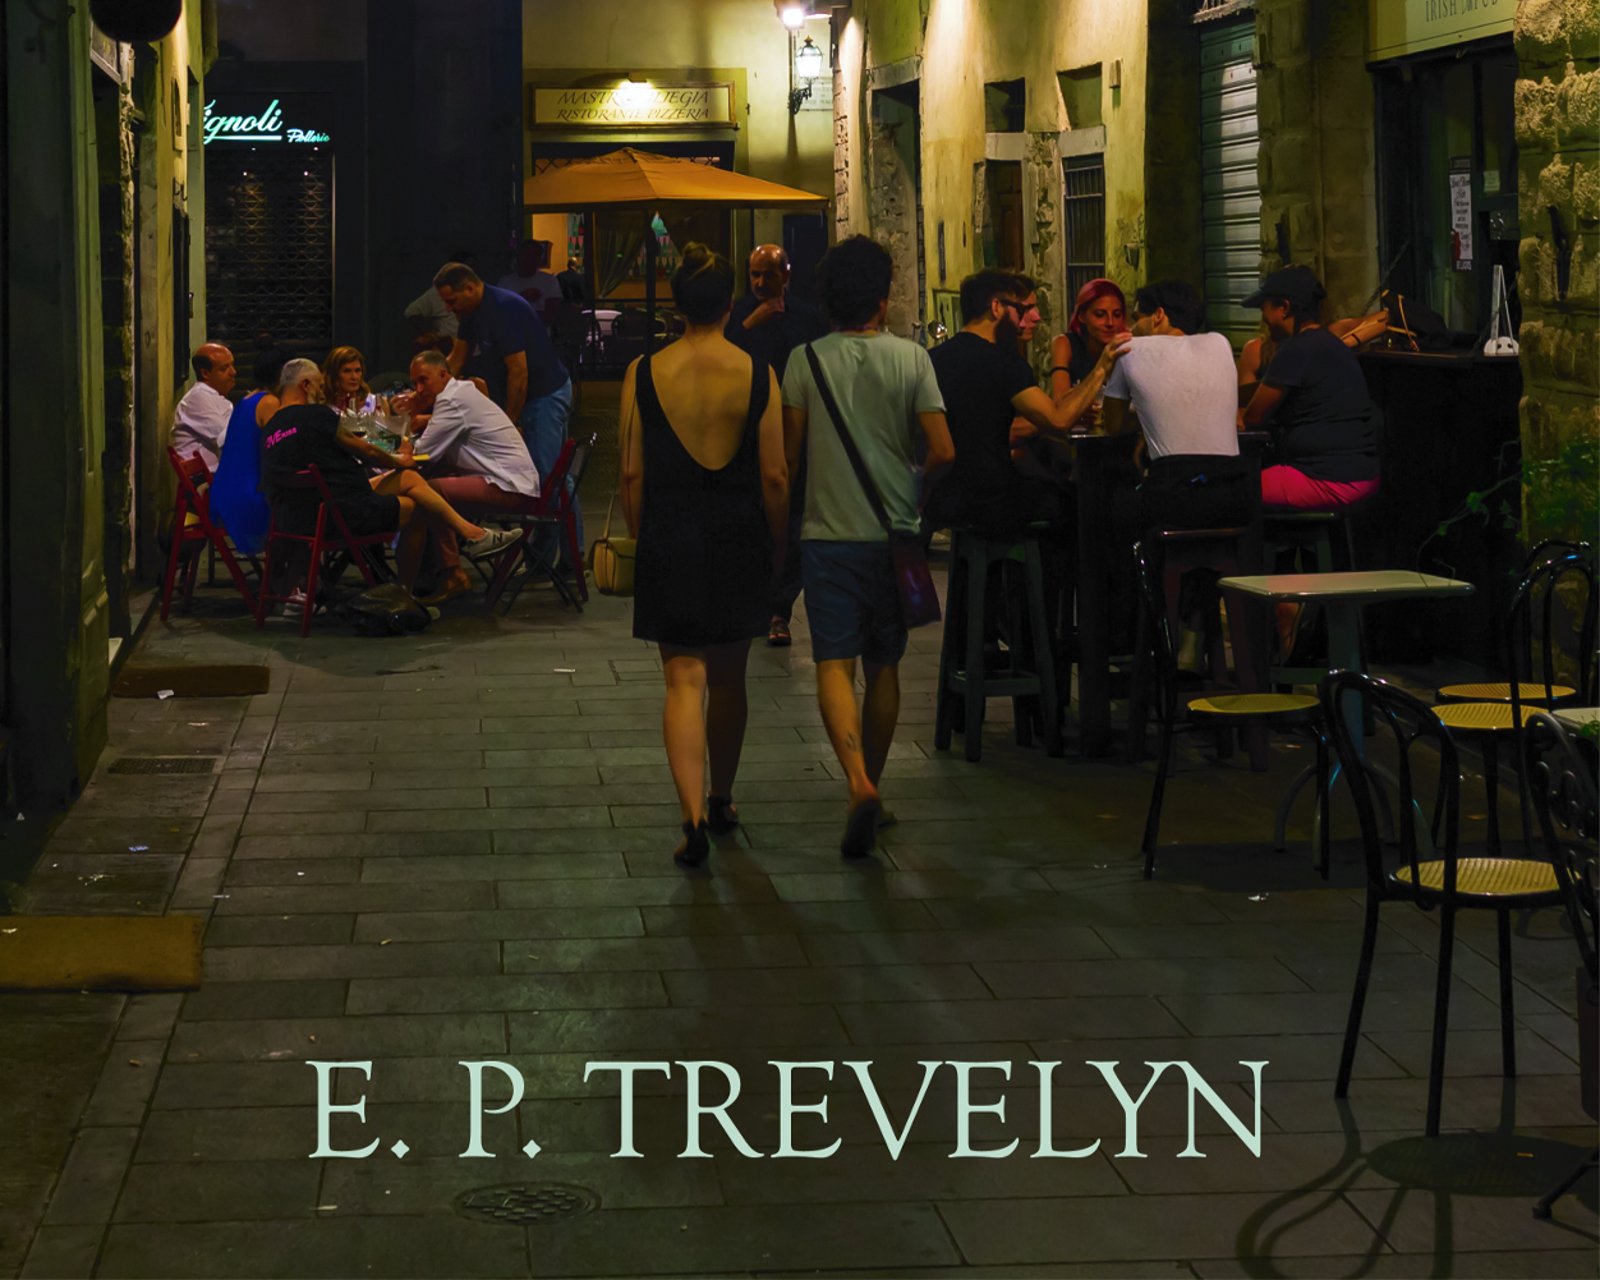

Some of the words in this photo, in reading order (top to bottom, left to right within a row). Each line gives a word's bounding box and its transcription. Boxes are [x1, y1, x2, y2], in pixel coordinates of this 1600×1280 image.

[557, 91, 629, 106] MASTR
[556, 107, 642, 121] RISTORANTE
[646, 107, 709, 120] PIZZERIA
[203, 99, 283, 145] ignoli
